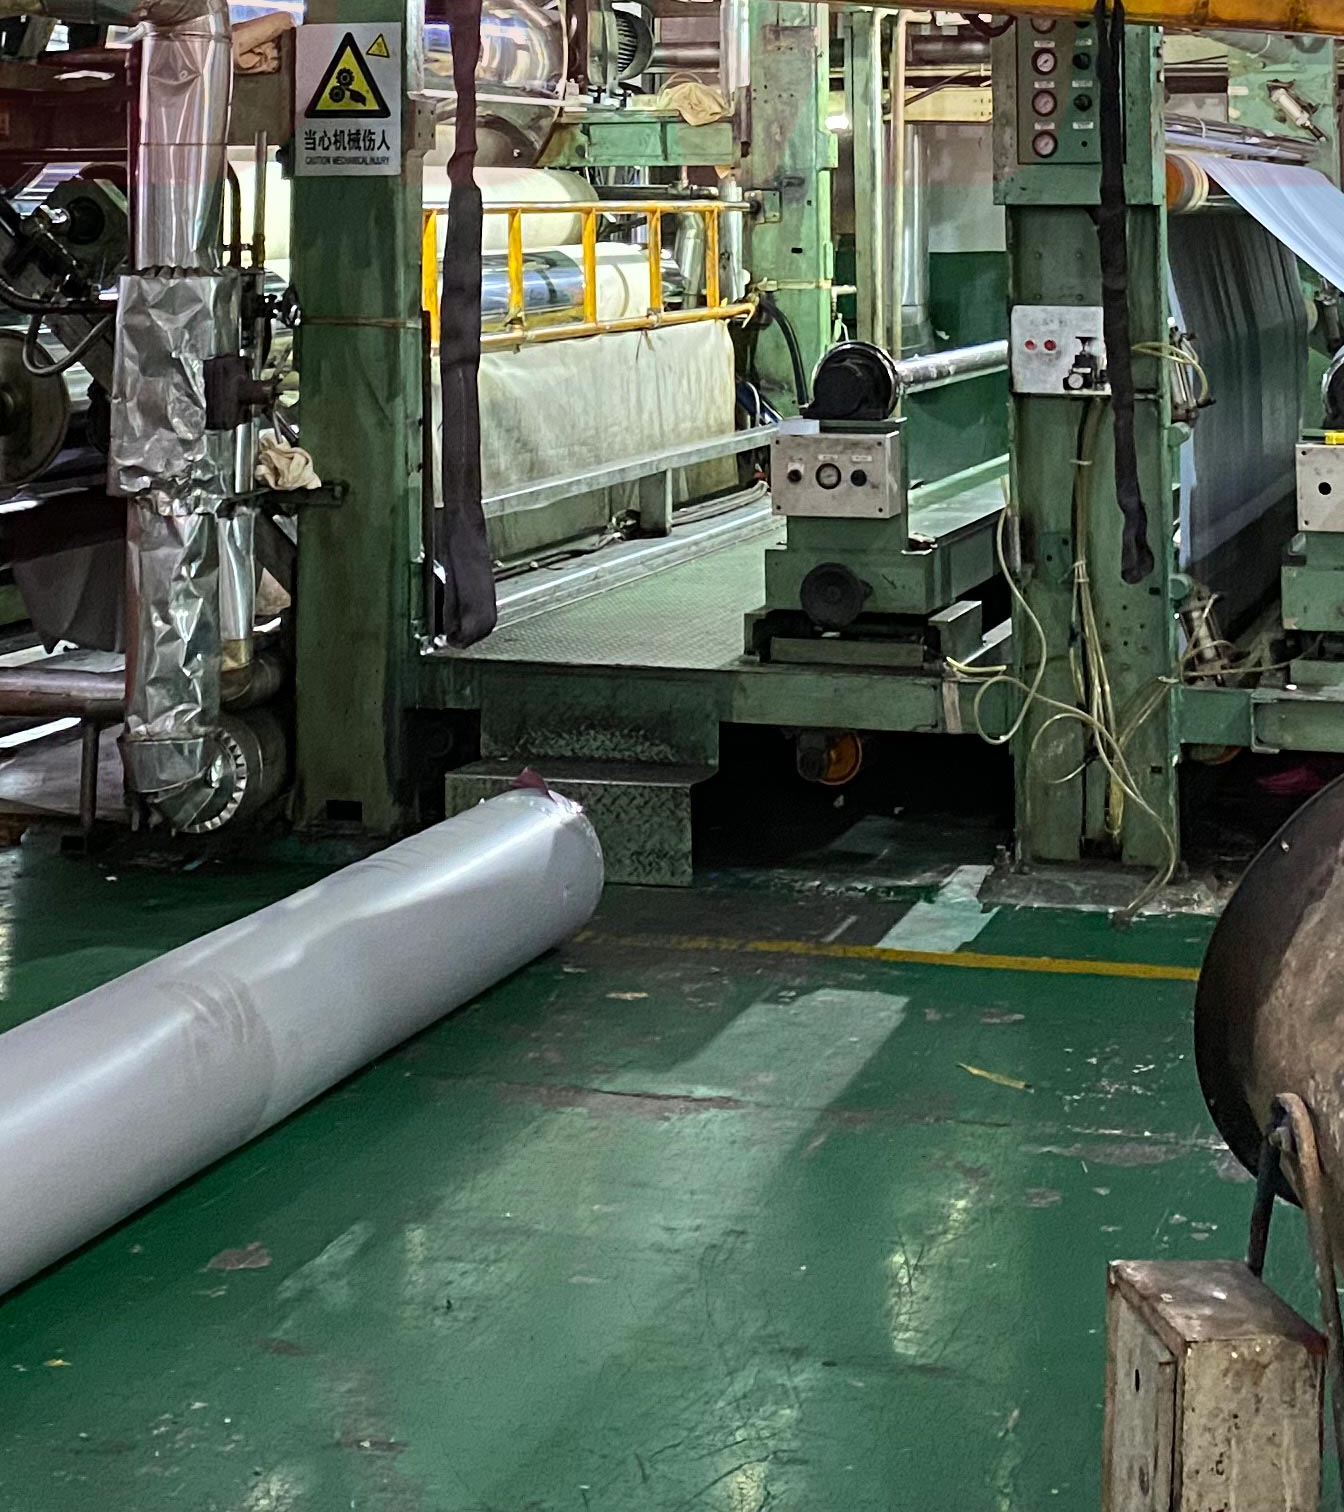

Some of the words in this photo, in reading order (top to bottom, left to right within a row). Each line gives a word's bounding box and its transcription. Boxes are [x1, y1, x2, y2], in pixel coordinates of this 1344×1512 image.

[304, 129, 390, 151] 当心机械伤人
